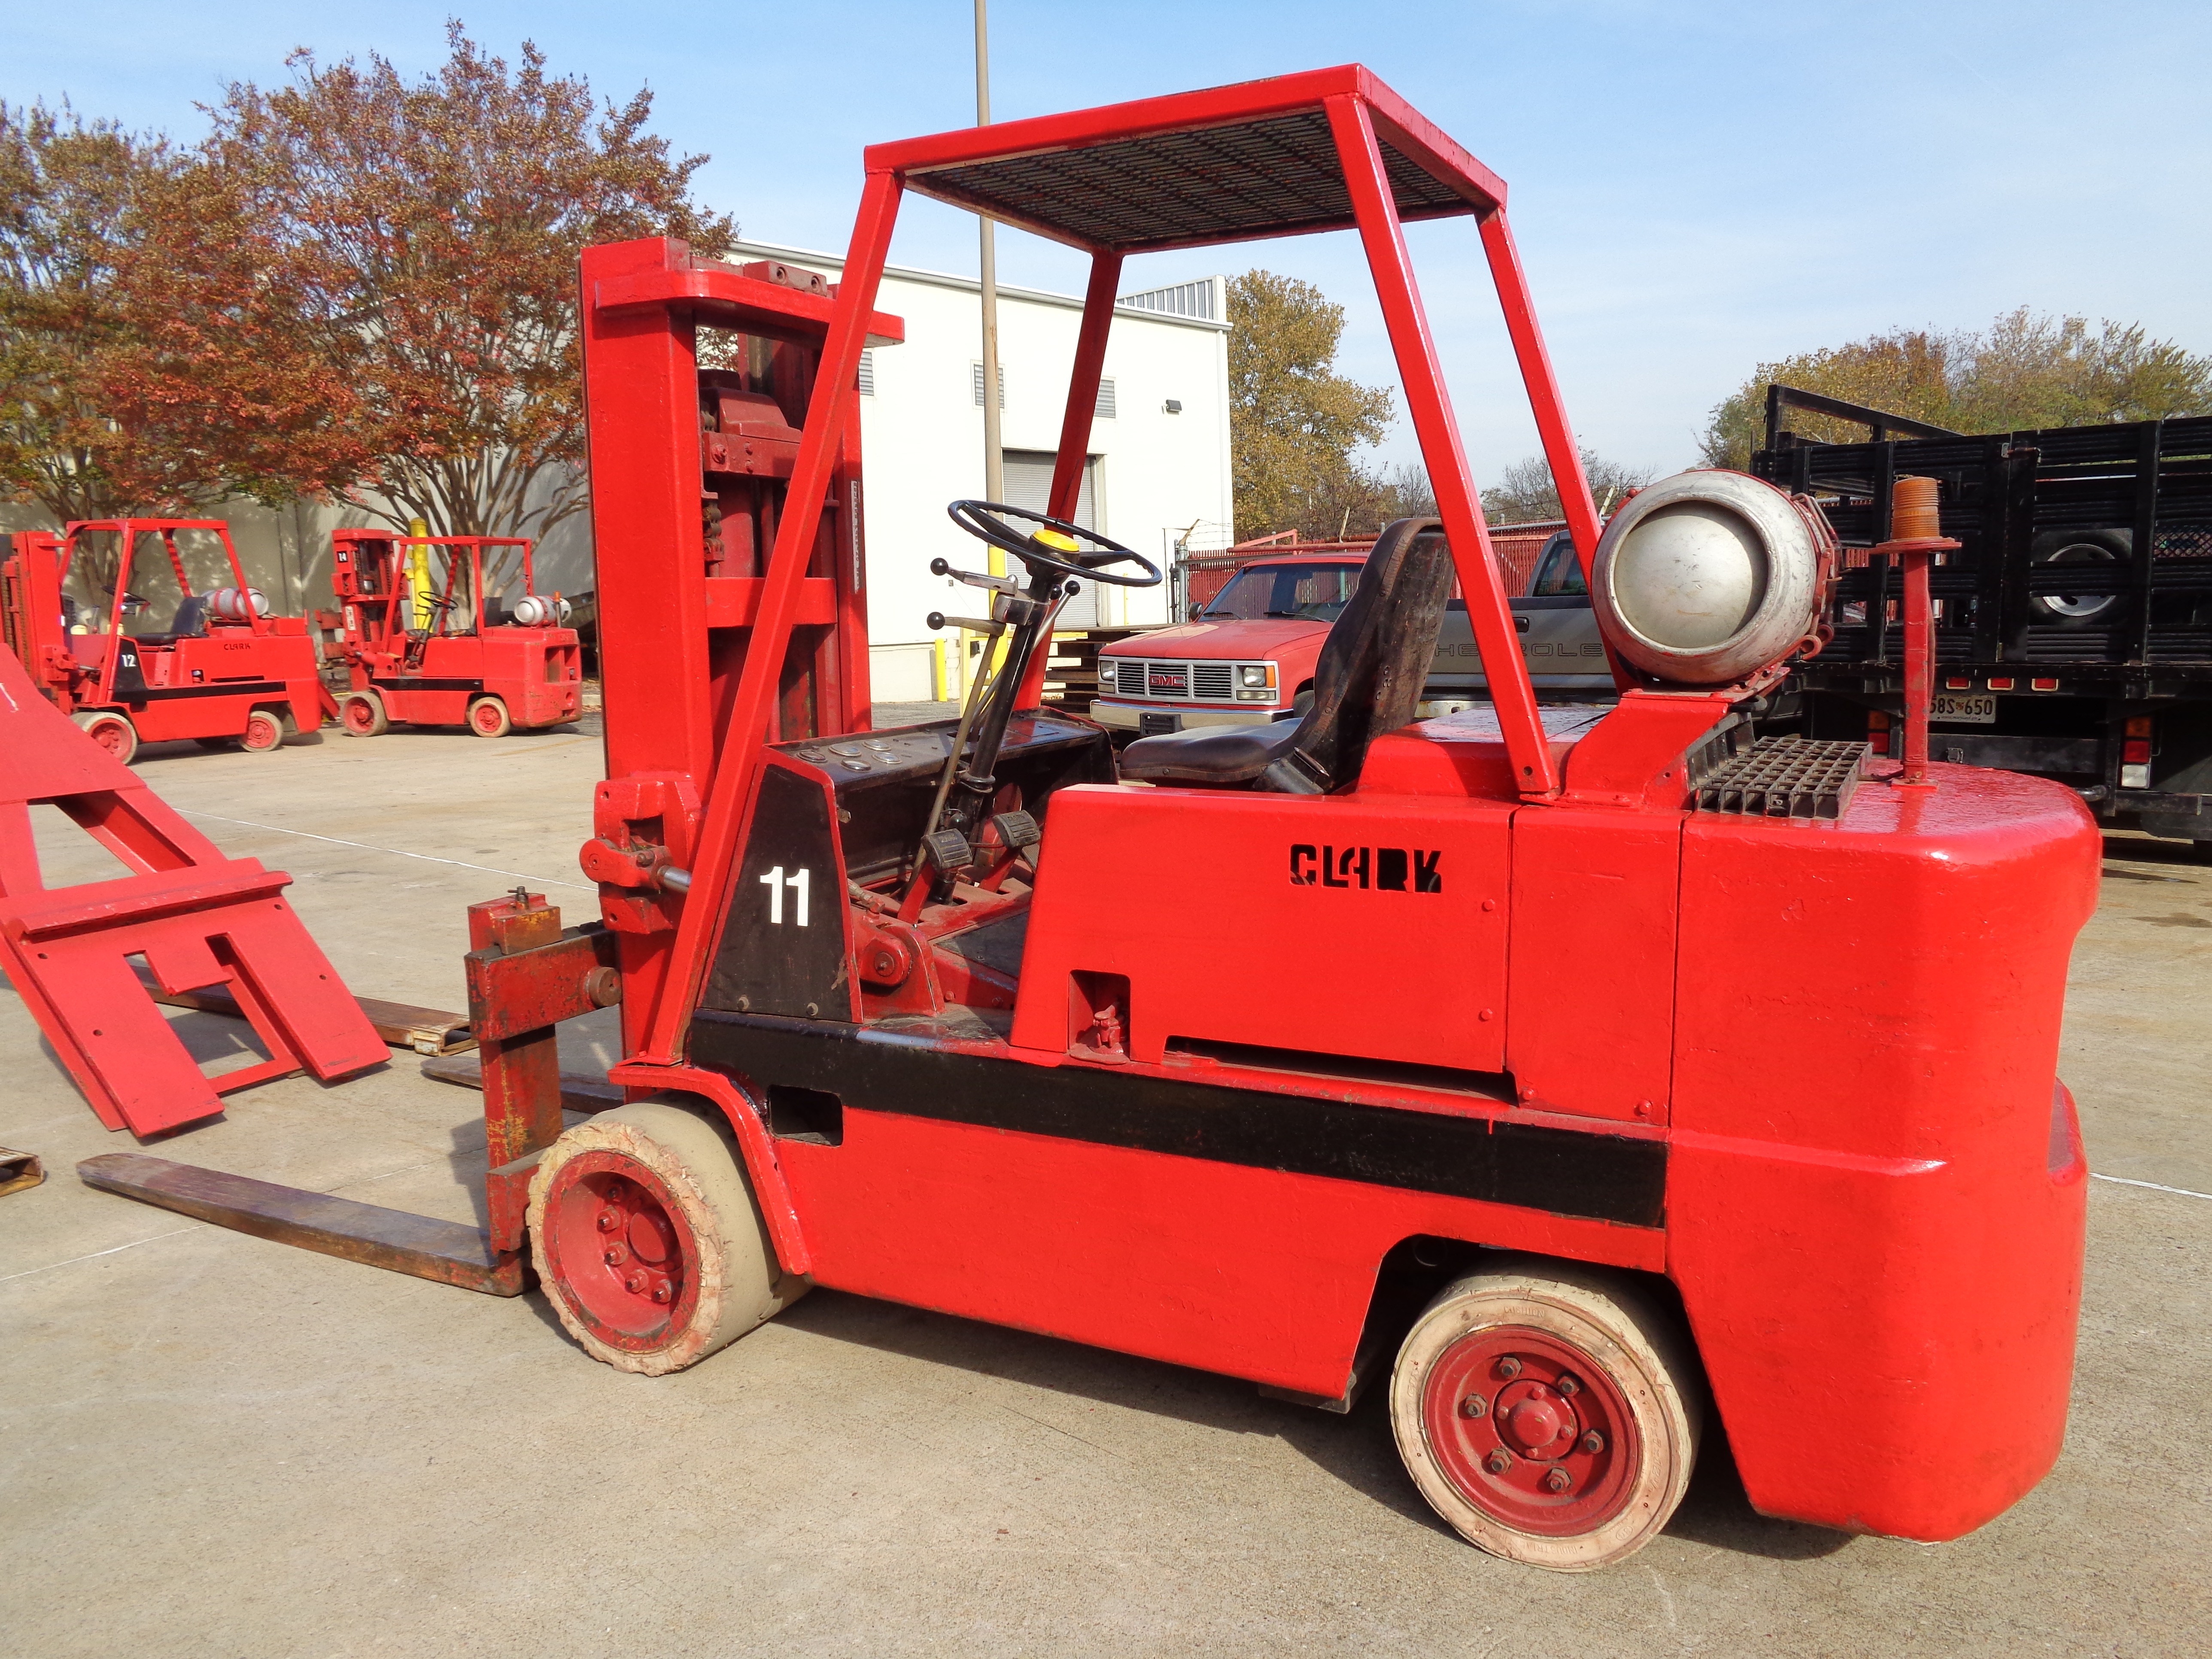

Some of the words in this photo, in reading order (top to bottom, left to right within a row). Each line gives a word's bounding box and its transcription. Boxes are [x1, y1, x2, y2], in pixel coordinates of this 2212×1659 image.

[339, 553, 346, 561] 14
[122, 655, 136, 667] 12
[1150, 675, 1185, 686] GMC
[1290, 844, 1441, 893] CLARK
[760, 866, 809, 927] 11
[1504, 1306, 1544, 1318] CUSHION
